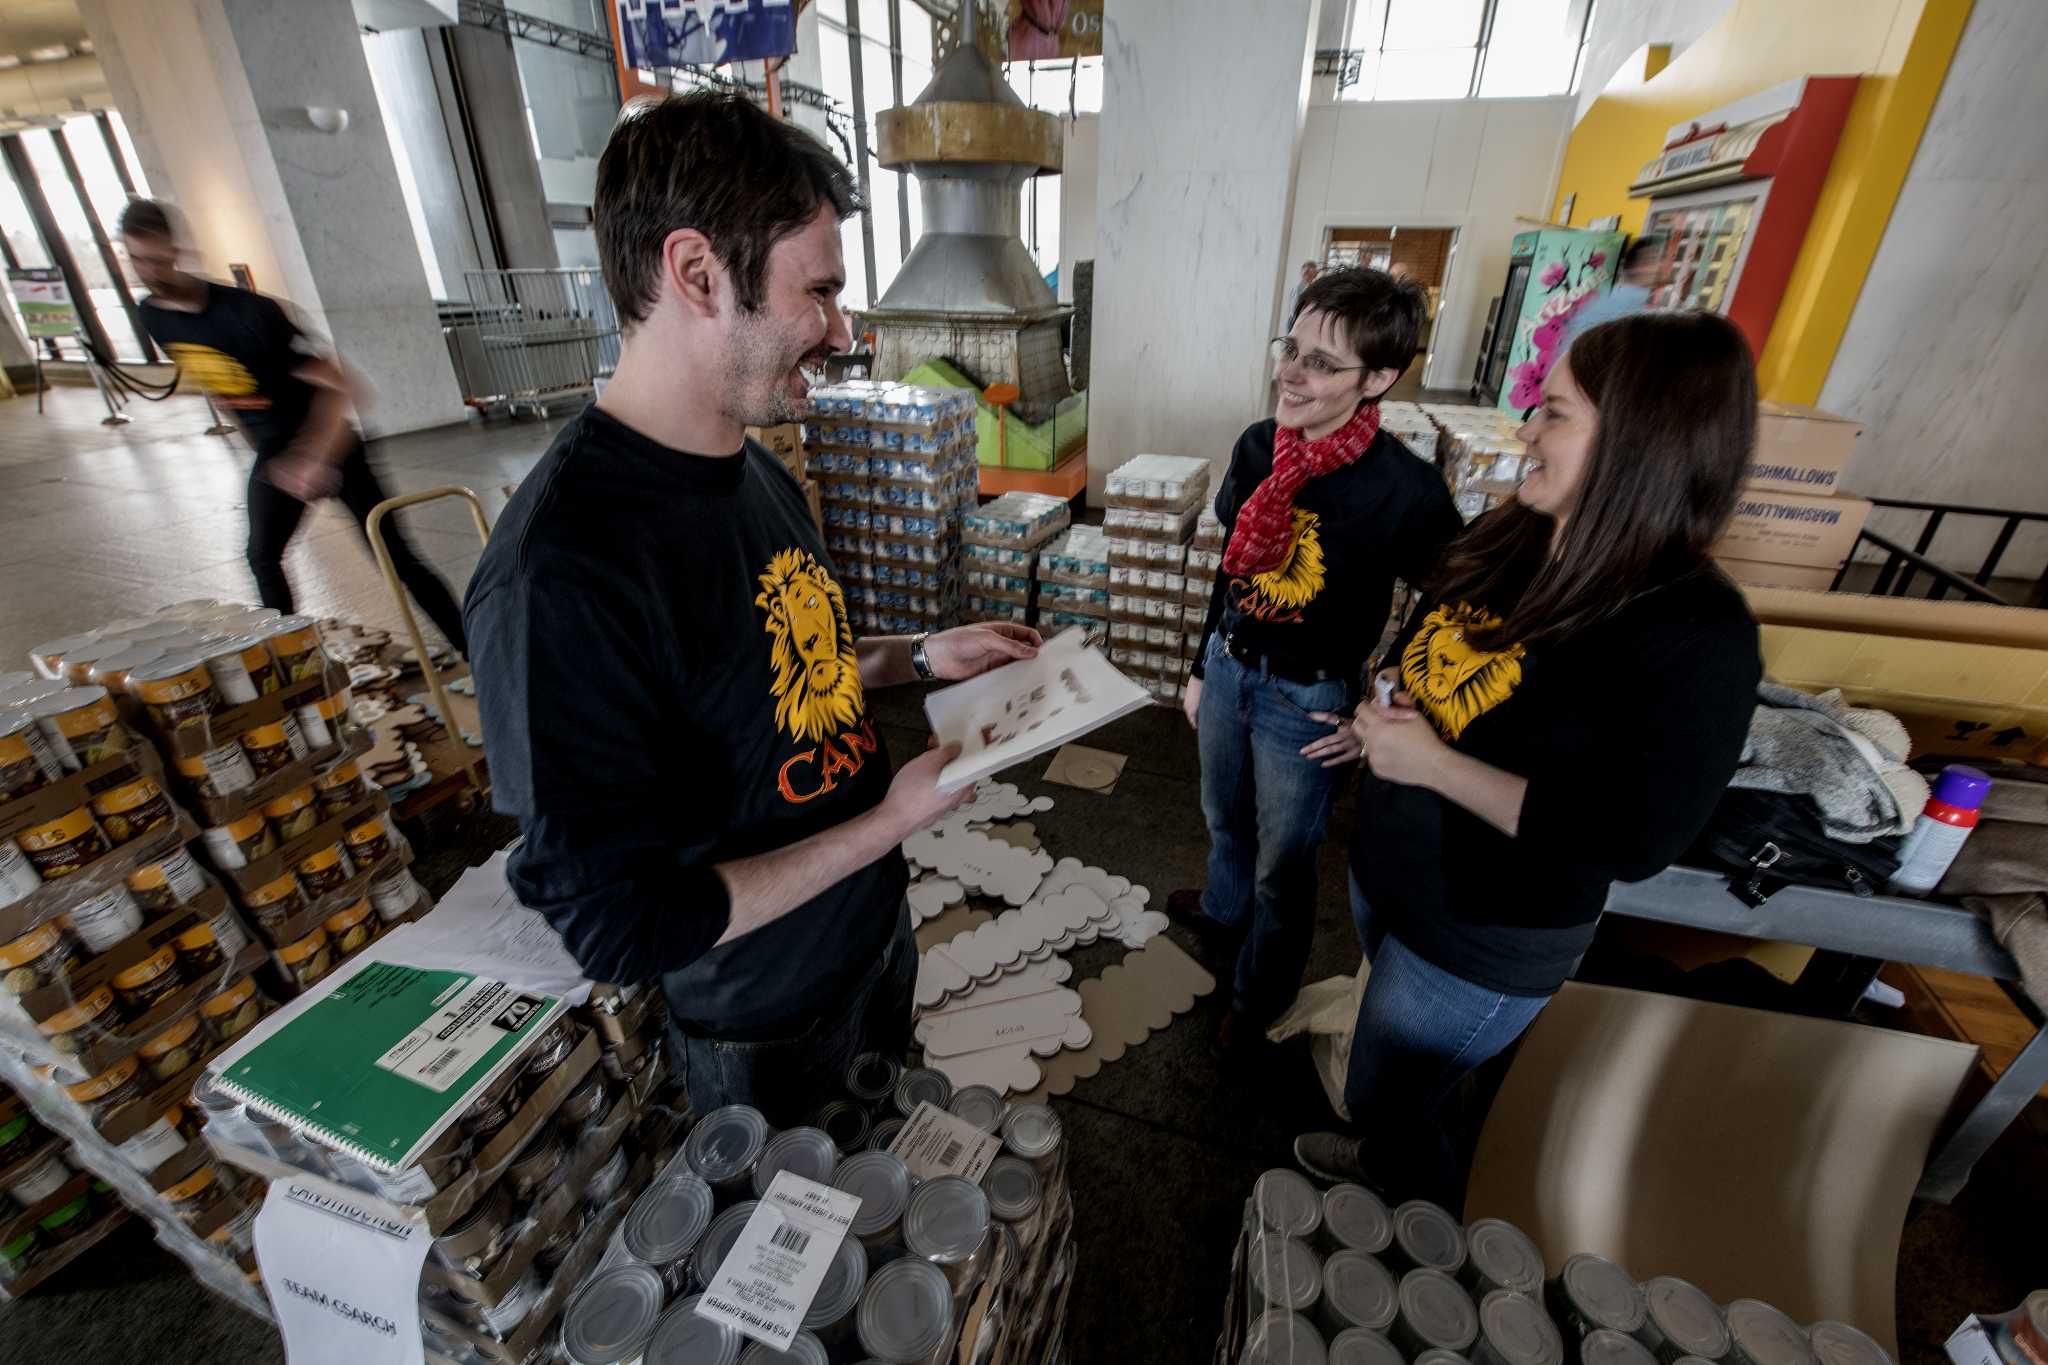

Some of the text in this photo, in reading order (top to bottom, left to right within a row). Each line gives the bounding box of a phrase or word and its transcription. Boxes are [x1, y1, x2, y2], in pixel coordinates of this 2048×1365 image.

[499, 999, 530, 1025] 70
[282, 1278, 397, 1338] TEAM CSARCH
[739, 1309, 762, 1326] PRICE
[761, 1319, 773, 1331] BY
